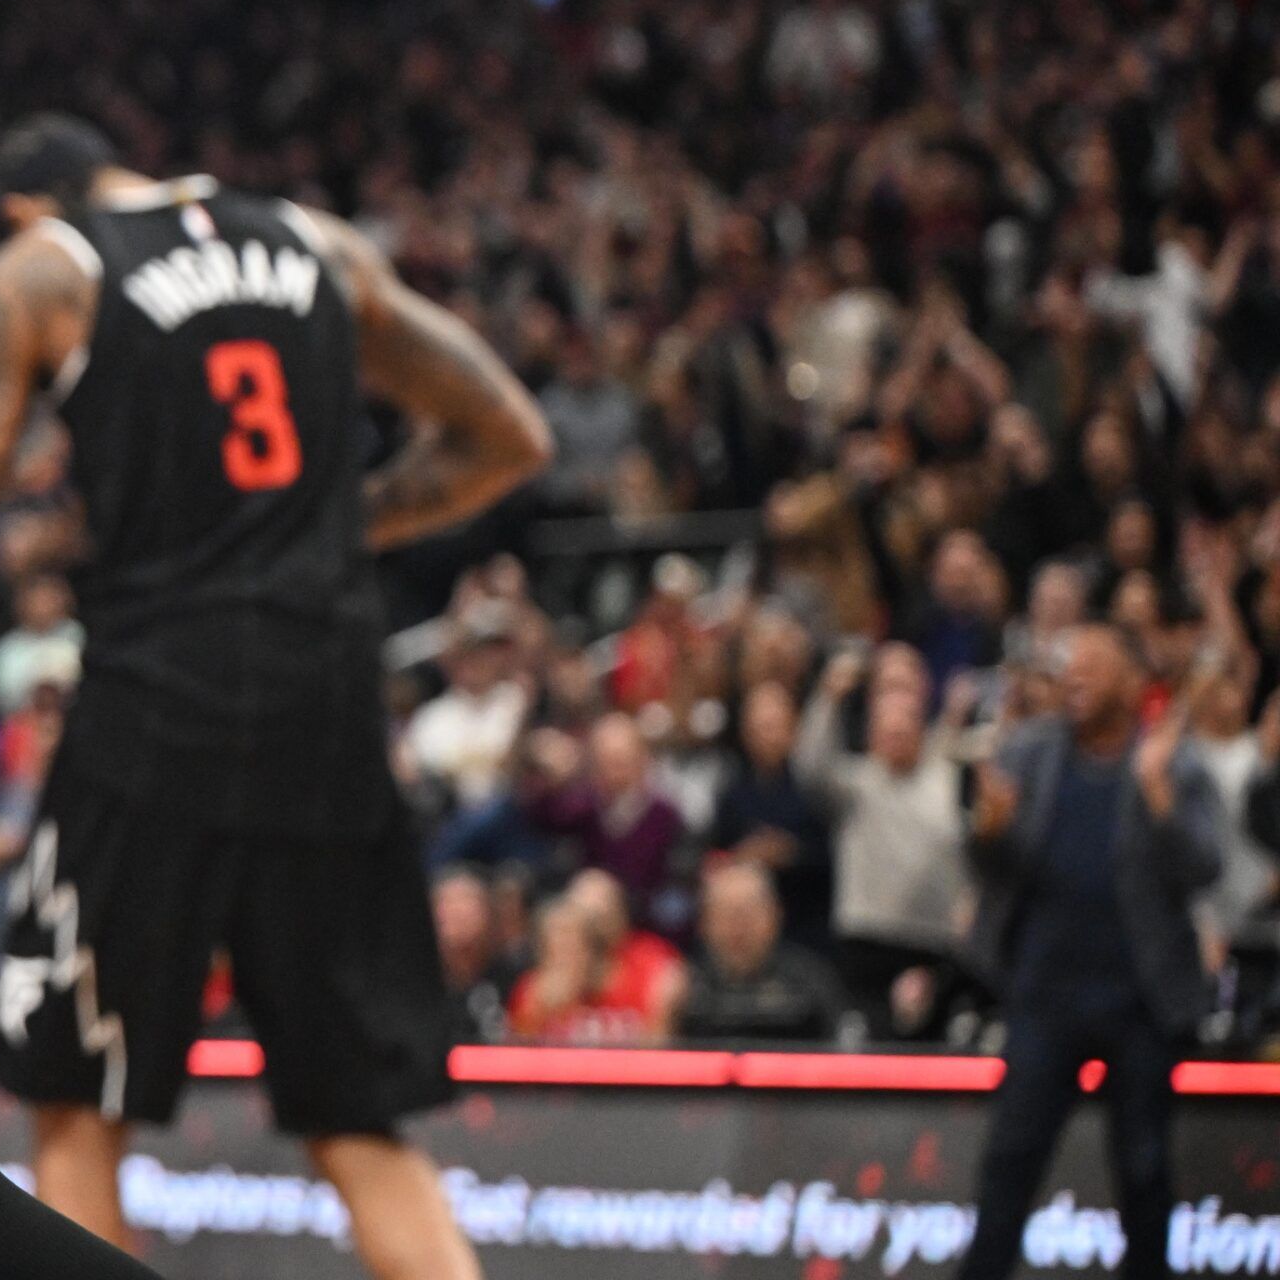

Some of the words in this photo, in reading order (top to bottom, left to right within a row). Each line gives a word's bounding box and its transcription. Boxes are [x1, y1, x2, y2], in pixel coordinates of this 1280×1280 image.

[122, 238, 320, 333] INGRAM
[204, 338, 304, 493] 3
[526, 1178, 796, 1257] rewarded
[792, 1180, 882, 1261] for
